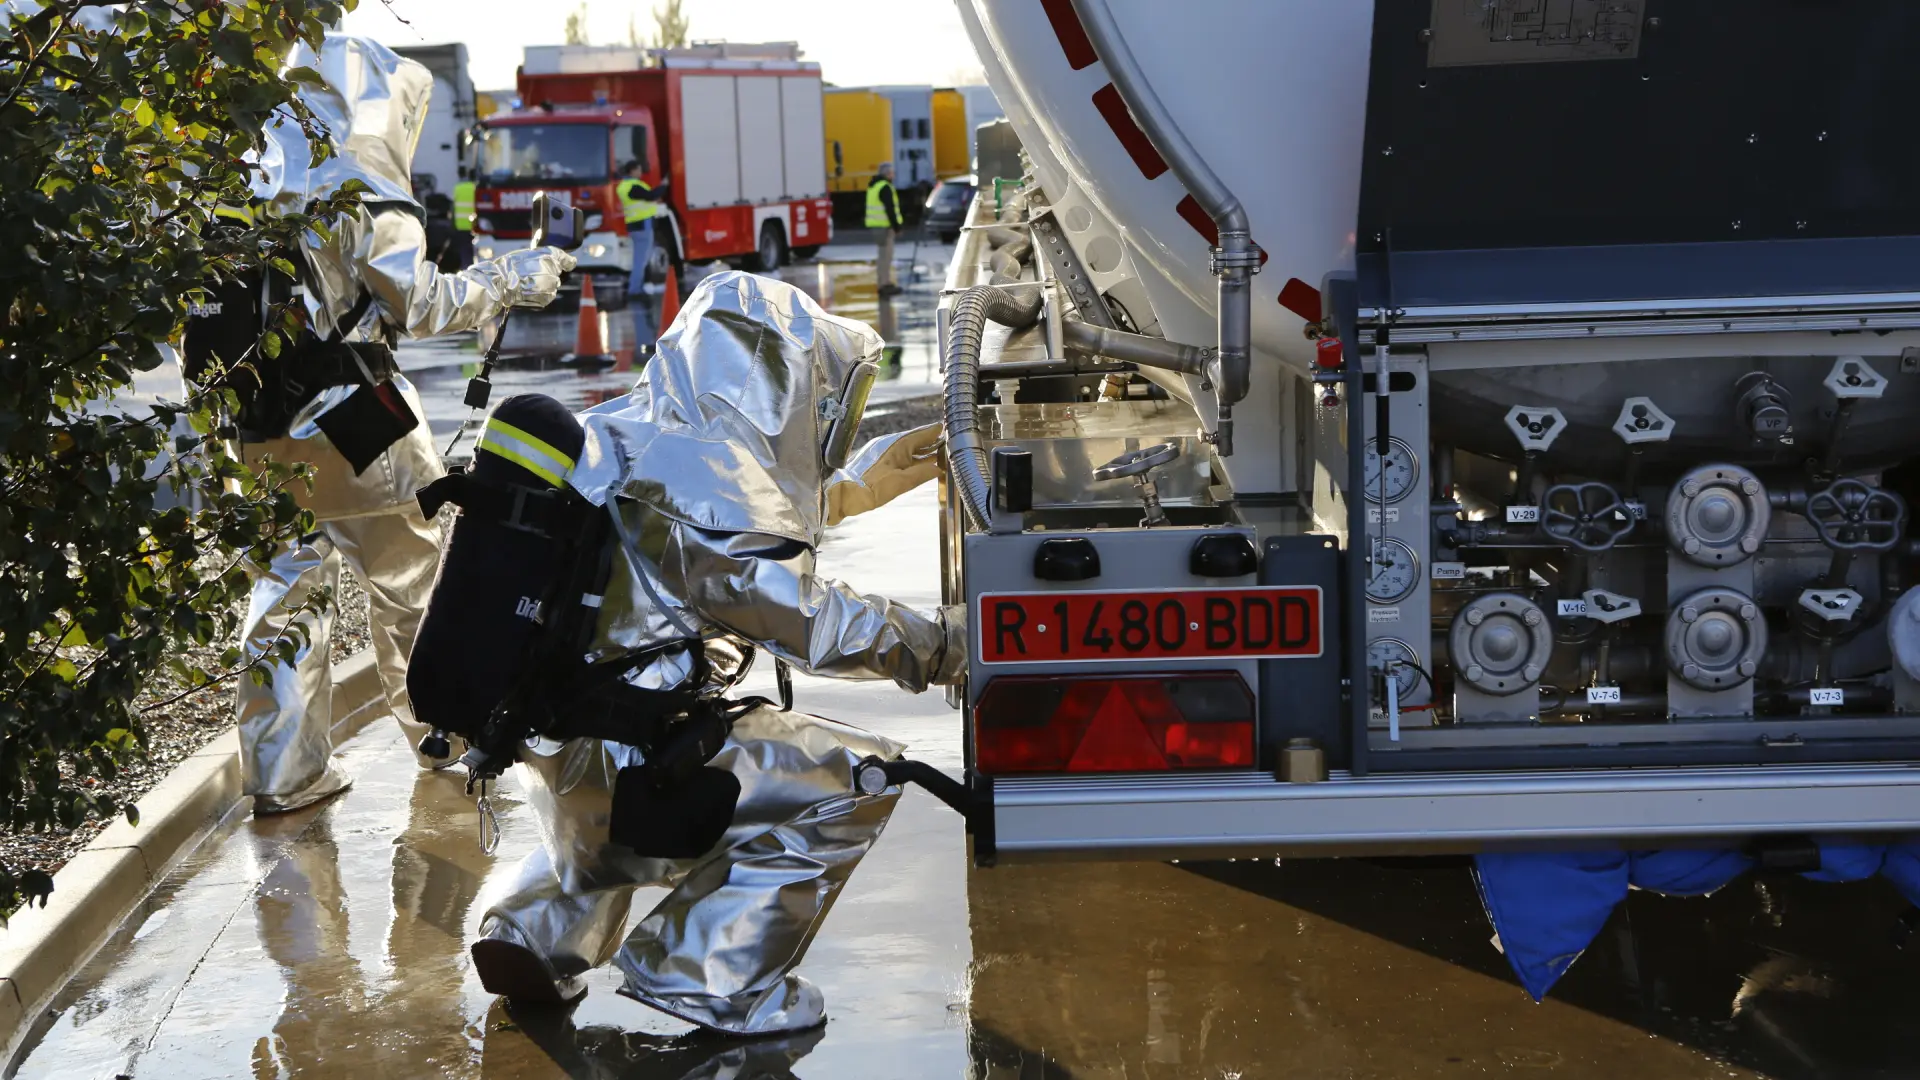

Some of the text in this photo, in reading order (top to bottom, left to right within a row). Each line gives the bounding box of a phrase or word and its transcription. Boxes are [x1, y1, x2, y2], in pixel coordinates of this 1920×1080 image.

[1765, 419, 1781, 428] VP
[1511, 510, 1535, 519] V-29
[1436, 567, 1461, 577] Pump
[1562, 603, 1586, 613] V-16
[994, 596, 1310, 655] R 1480 BDD
[1590, 691, 1619, 700] V-7-6
[1813, 692, 1841, 702] V-7-3
